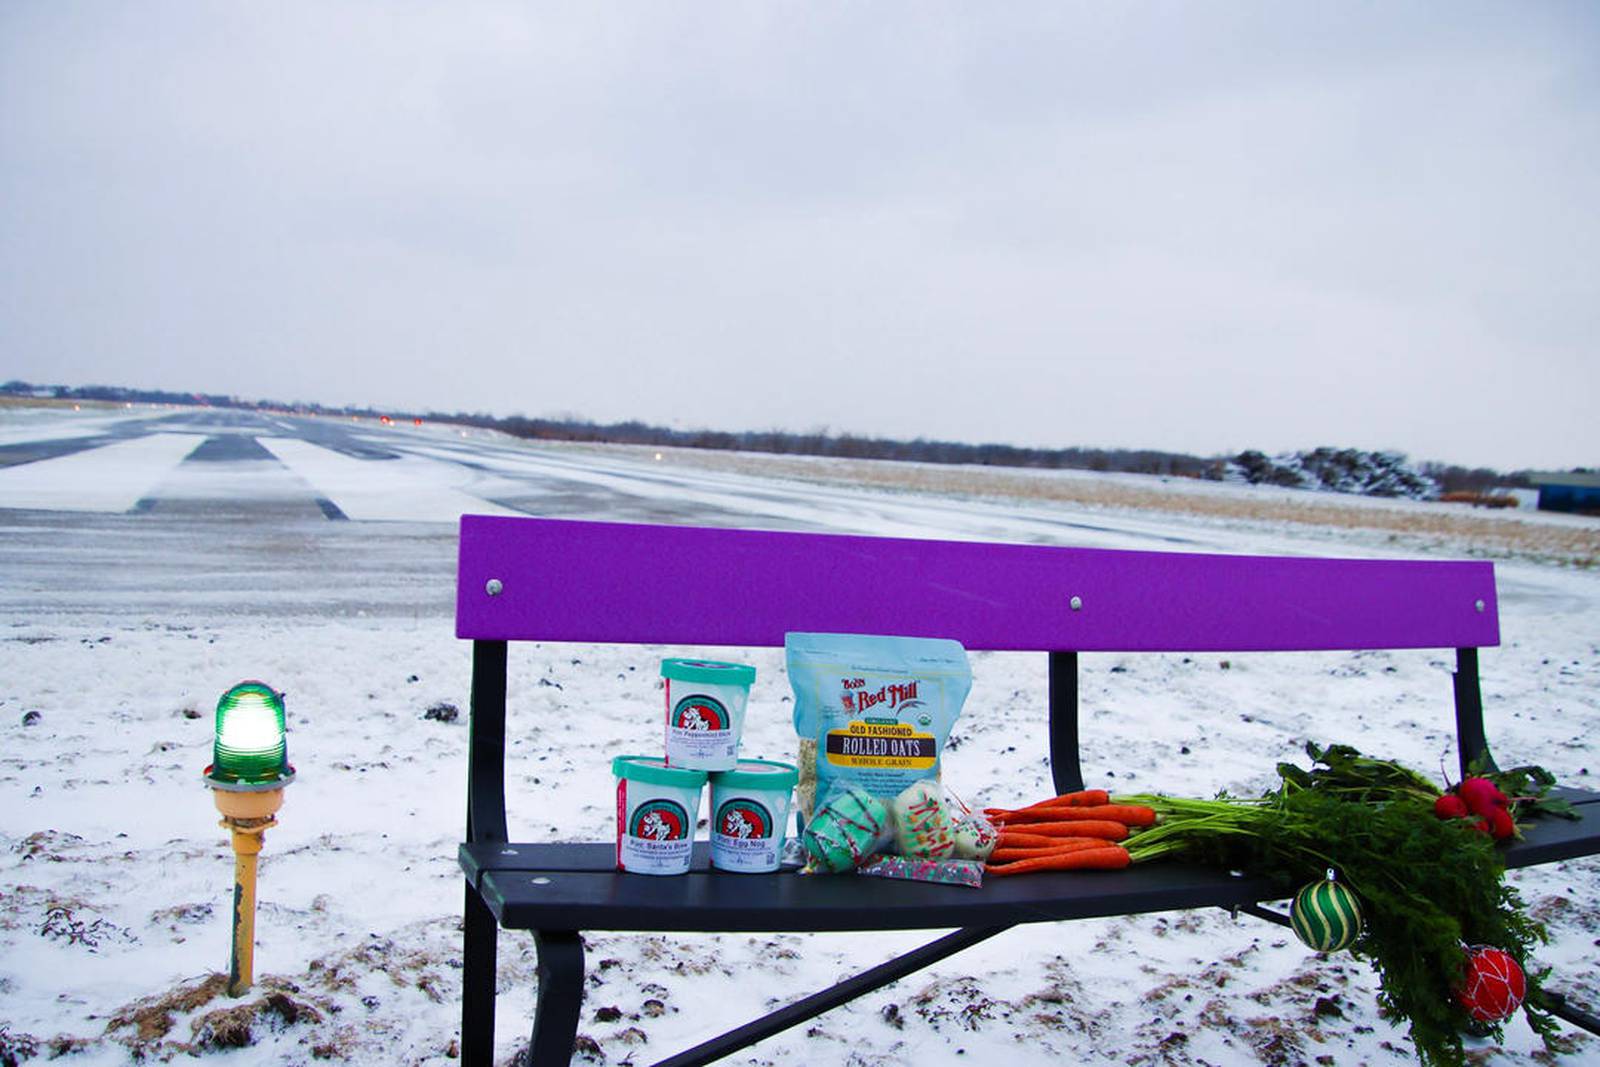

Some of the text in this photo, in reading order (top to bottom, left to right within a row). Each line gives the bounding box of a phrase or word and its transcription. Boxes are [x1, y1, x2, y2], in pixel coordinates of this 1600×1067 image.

[858, 686, 886, 714] Red
[887, 681, 917, 708] Mill
[849, 725, 912, 736] OLD FASHIONED
[842, 737, 920, 757] ROLLED OATS
